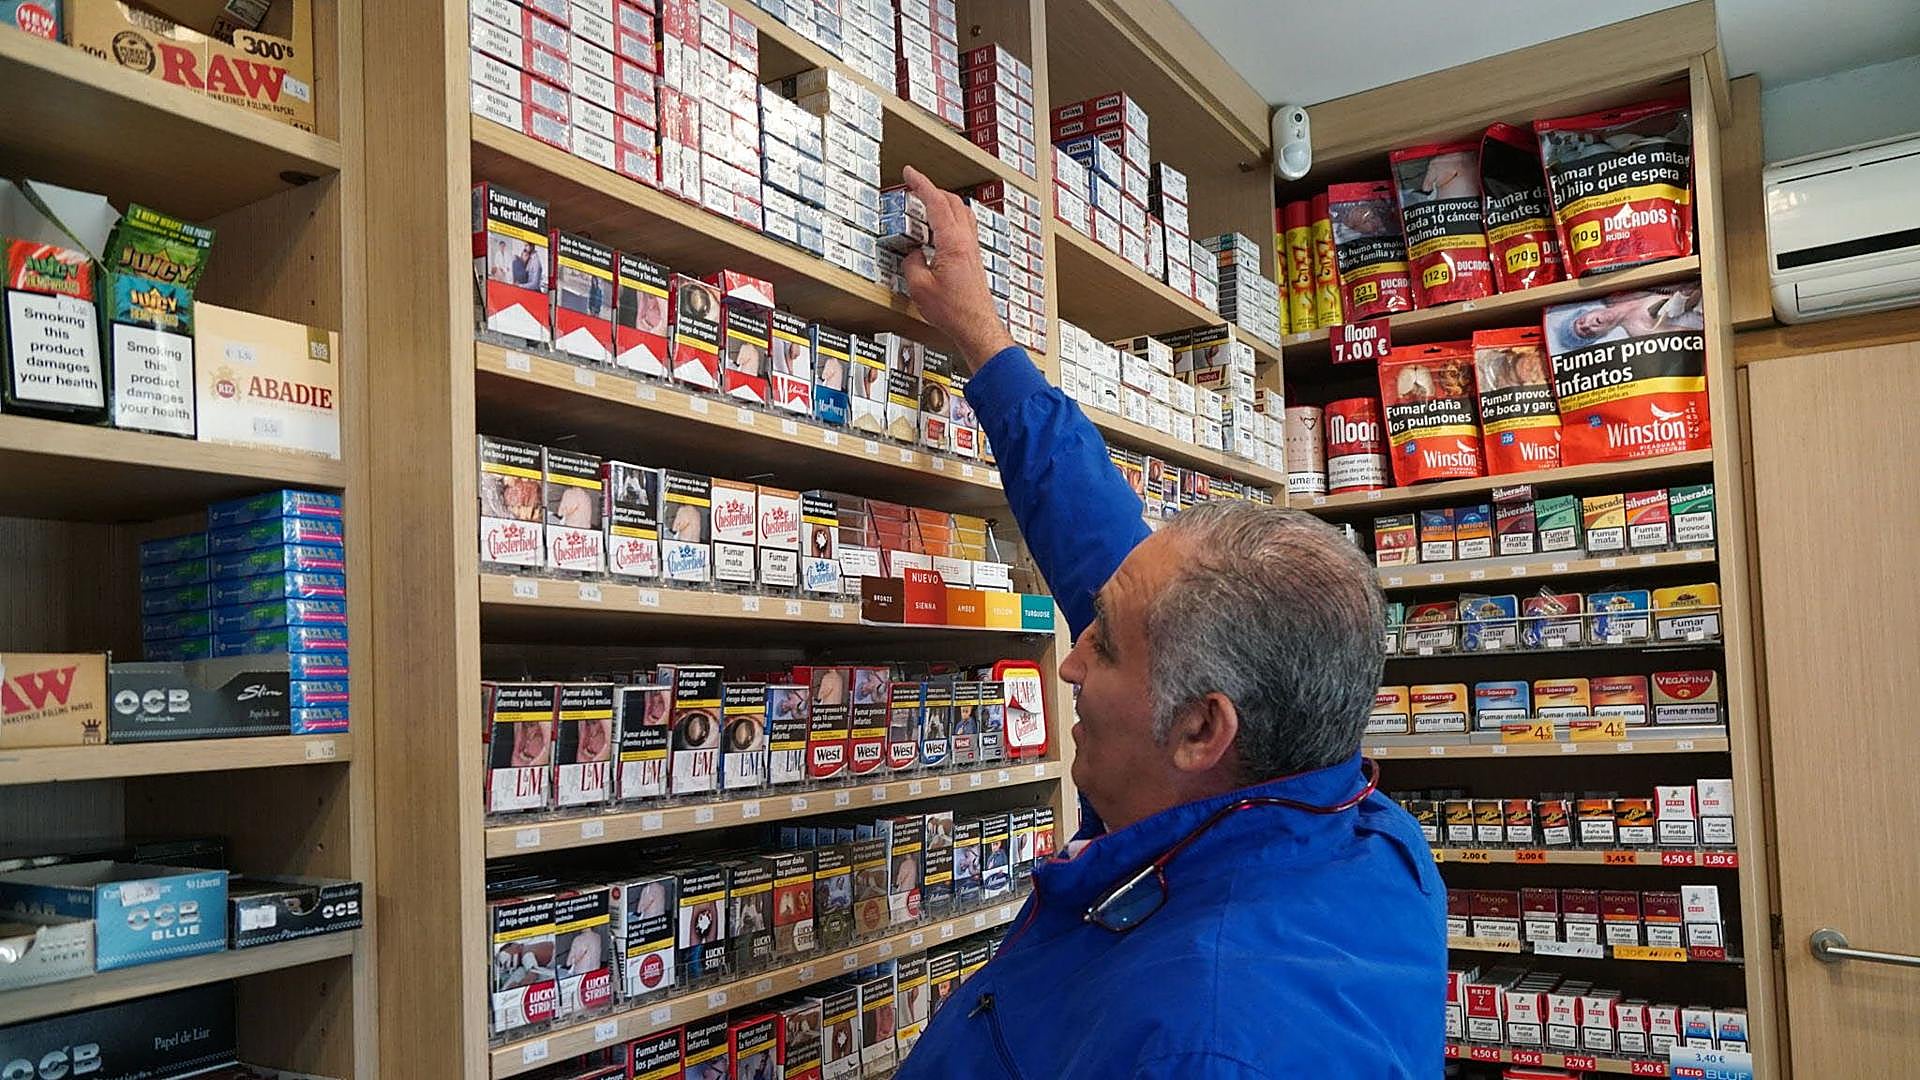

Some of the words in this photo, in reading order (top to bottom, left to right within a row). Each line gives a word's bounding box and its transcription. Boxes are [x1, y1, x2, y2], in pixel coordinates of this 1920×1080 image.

[158, 43, 288, 104] RAW
[1550, 165, 1594, 188] Fumar
[1597, 151, 1647, 175] puede
[1554, 188, 1566, 206] al
[1568, 180, 1594, 200] hijo
[1598, 173, 1628, 191] que
[1631, 168, 1679, 184] espera
[489, 189, 518, 208] Fumar
[518, 199, 546, 218] reduce
[1486, 189, 1529, 210] Fumar
[1532, 186, 1550, 199] da
[489, 202, 498, 215] la
[500, 206, 539, 228] fertilidad
[1404, 203, 1435, 221] Fumar
[1438, 199, 1479, 216] provoca
[1488, 202, 1541, 225] dientes
[1406, 217, 1429, 233] cada
[1431, 214, 1445, 225] 10
[1604, 208, 1668, 232] DUCADOS
[1408, 226, 1447, 246] pulmón
[1590, 231, 1599, 243] g
[1605, 231, 1631, 242] RUBIO
[1337, 250, 1347, 260] Su
[1348, 245, 1372, 257] humo
[1372, 242, 1382, 250] es
[1360, 250, 1389, 263] familia
[1389, 250, 1395, 259] y
[1508, 251, 1528, 267] 170
[1532, 251, 1539, 263] g
[120, 246, 198, 283] JUICY
[1457, 261, 1491, 271] DUCADOS
[1424, 271, 1440, 283] 112
[1441, 270, 1448, 281] g
[24, 306, 85, 328] Smoking
[44, 326, 70, 340] this
[1344, 324, 1378, 342] Moon
[30, 342, 85, 357] product
[1335, 341, 1373, 361] 7.00
[1377, 338, 1389, 356] €
[1552, 347, 1615, 375] Fumar
[1622, 335, 1704, 362] provoca
[26, 356, 90, 374] damages
[20, 372, 52, 384] your
[56, 375, 99, 390] health
[131, 373, 180, 388] product
[1555, 366, 1633, 397] infartos
[248, 376, 333, 409] ABADIE
[1481, 394, 1513, 407] Fumar
[1515, 389, 1553, 403] provoc
[1386, 404, 1426, 420] Fumar
[1429, 400, 1461, 412] daña
[1482, 408, 1495, 418] de
[1496, 403, 1521, 416] boca
[1522, 403, 1530, 414] y
[1531, 401, 1557, 413] garg
[1331, 414, 1380, 446] Moon
[1389, 417, 1405, 434] los
[1407, 412, 1472, 429] pulmones
[1606, 421, 1687, 449] Winston
[1424, 449, 1477, 468] Winston
[1492, 485, 1531, 499] Silverado
[1626, 490, 1668, 510] Silverado
[1670, 488, 1713, 505] Silverado
[714, 505, 754, 533] Chesterfield
[761, 513, 798, 539] Chesterfield
[1457, 522, 1488, 530] AMIGOS
[1678, 524, 1711, 534] provoca
[488, 529, 538, 560] Chesterfield
[554, 537, 599, 566] Chesterfield
[723, 546, 745, 557] Fumar
[725, 558, 743, 567] mata
[768, 552, 790, 561] Fumar
[911, 572, 940, 585] NUEVO
[873, 594, 893, 604] BRONZE
[915, 602, 937, 611] SIENNA
[1024, 609, 1051, 619] TURQUOISE
[1671, 618, 1705, 628] Fumar
[1656, 676, 1711, 686] VEGAFINA
[237, 684, 284, 702] Slim
[498, 690, 519, 698] Fumar
[533, 689, 542, 697] los
[114, 688, 192, 715] OCB
[1657, 706, 1689, 716] Fumar
[1690, 707, 1716, 716] mata
[1416, 717, 1442, 726] Fumar
[1443, 717, 1464, 725] mata
[1604, 722, 1615, 738] 4
[817, 749, 841, 761] West
[856, 746, 879, 758] West
[893, 746, 914, 758] West
[926, 743, 945, 755] West
[1663, 854, 1685, 864] 4,50
[1685, 854, 1694, 863] €
[1705, 855, 1726, 865] 1,80
[1726, 855, 1734, 864] €
[127, 900, 200, 931] OCB
[322, 901, 359, 919] OCB
[498, 907, 518, 918] Fumar
[518, 905, 536, 917] puede
[536, 902, 554, 912] matar
[499, 919, 505, 927] al
[505, 916, 517, 928] hijo
[517, 914, 529, 926] que
[529, 912, 549, 924] espera
[152, 925, 200, 941] BLUE
[705, 946, 726, 960] LUCKY
[586, 975, 610, 990] LUCKY
[529, 988, 556, 1002] LUCKY
[585, 986, 611, 1001] STRIKE
[1471, 987, 1492, 996] REIG
[154, 1033, 179, 1050] Papel
[180, 1030, 193, 1044] de
[193, 1026, 211, 1040] Liar
[687, 1029, 705, 1041] Fumar
[635, 1045, 658, 1058] Fumar
[658, 1037, 677, 1051] daña
[687, 1038, 710, 1051] infartos
[1, 1042, 103, 1080] OCB
[635, 1058, 647, 1071] los
[647, 1050, 680, 1069] pulmones
[1472, 1048, 1491, 1058] 4,50
[1492, 1050, 1499, 1059] €
[1513, 1053, 1533, 1063] 4,50
[1533, 1055, 1541, 1064] €
[1695, 1053, 1717, 1063] 3,40
[1718, 1055, 1726, 1064] €
[1566, 1058, 1586, 1068] 2,70
[1586, 1059, 1594, 1069] €
